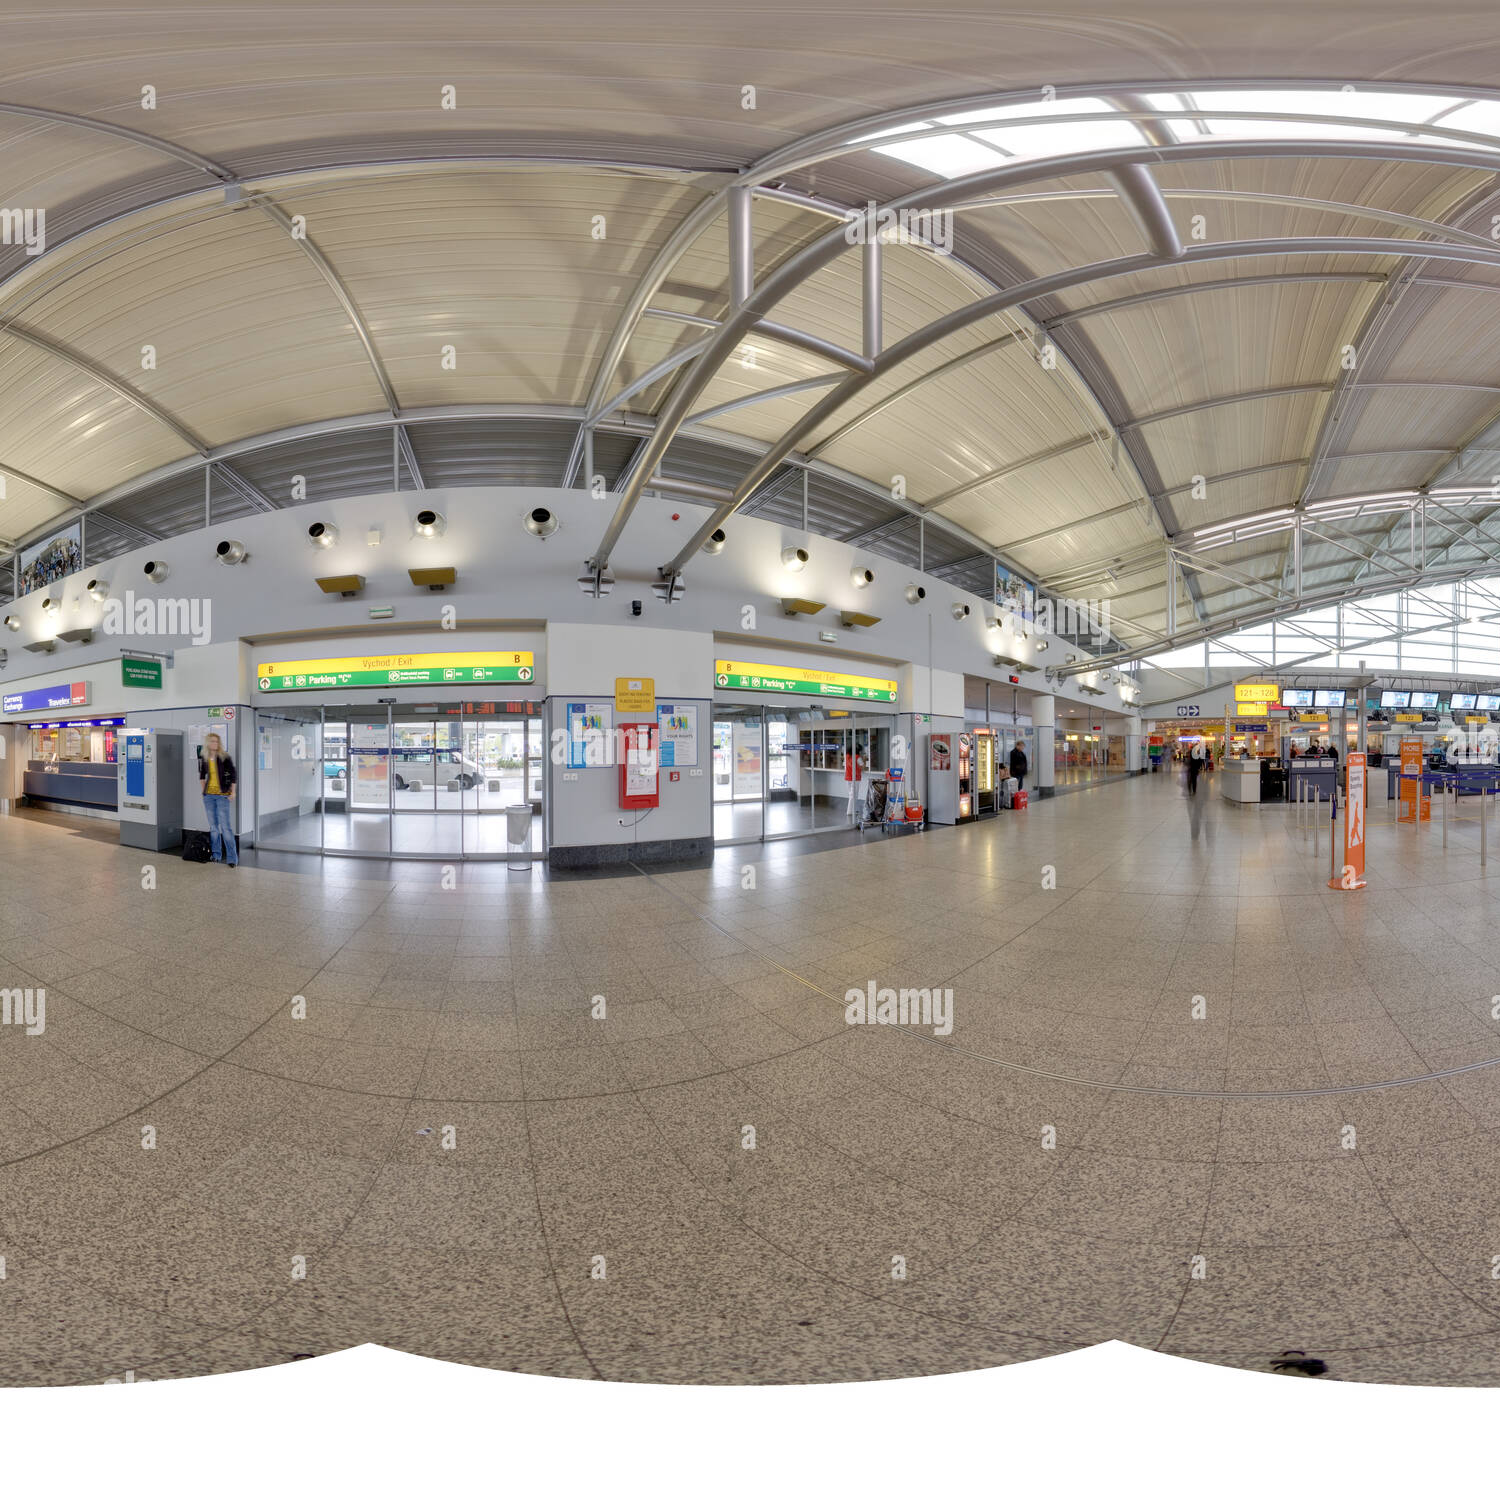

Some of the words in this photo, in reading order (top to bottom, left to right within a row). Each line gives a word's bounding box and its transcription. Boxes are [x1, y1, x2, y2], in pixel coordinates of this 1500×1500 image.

[398, 657, 412, 666] Exit
[514, 655, 520, 663] B
[268, 666, 274, 674] B
[308, 675, 336, 685] Parking
[762, 680, 784, 690] Parking
[48, 697, 70, 706] Travelex
